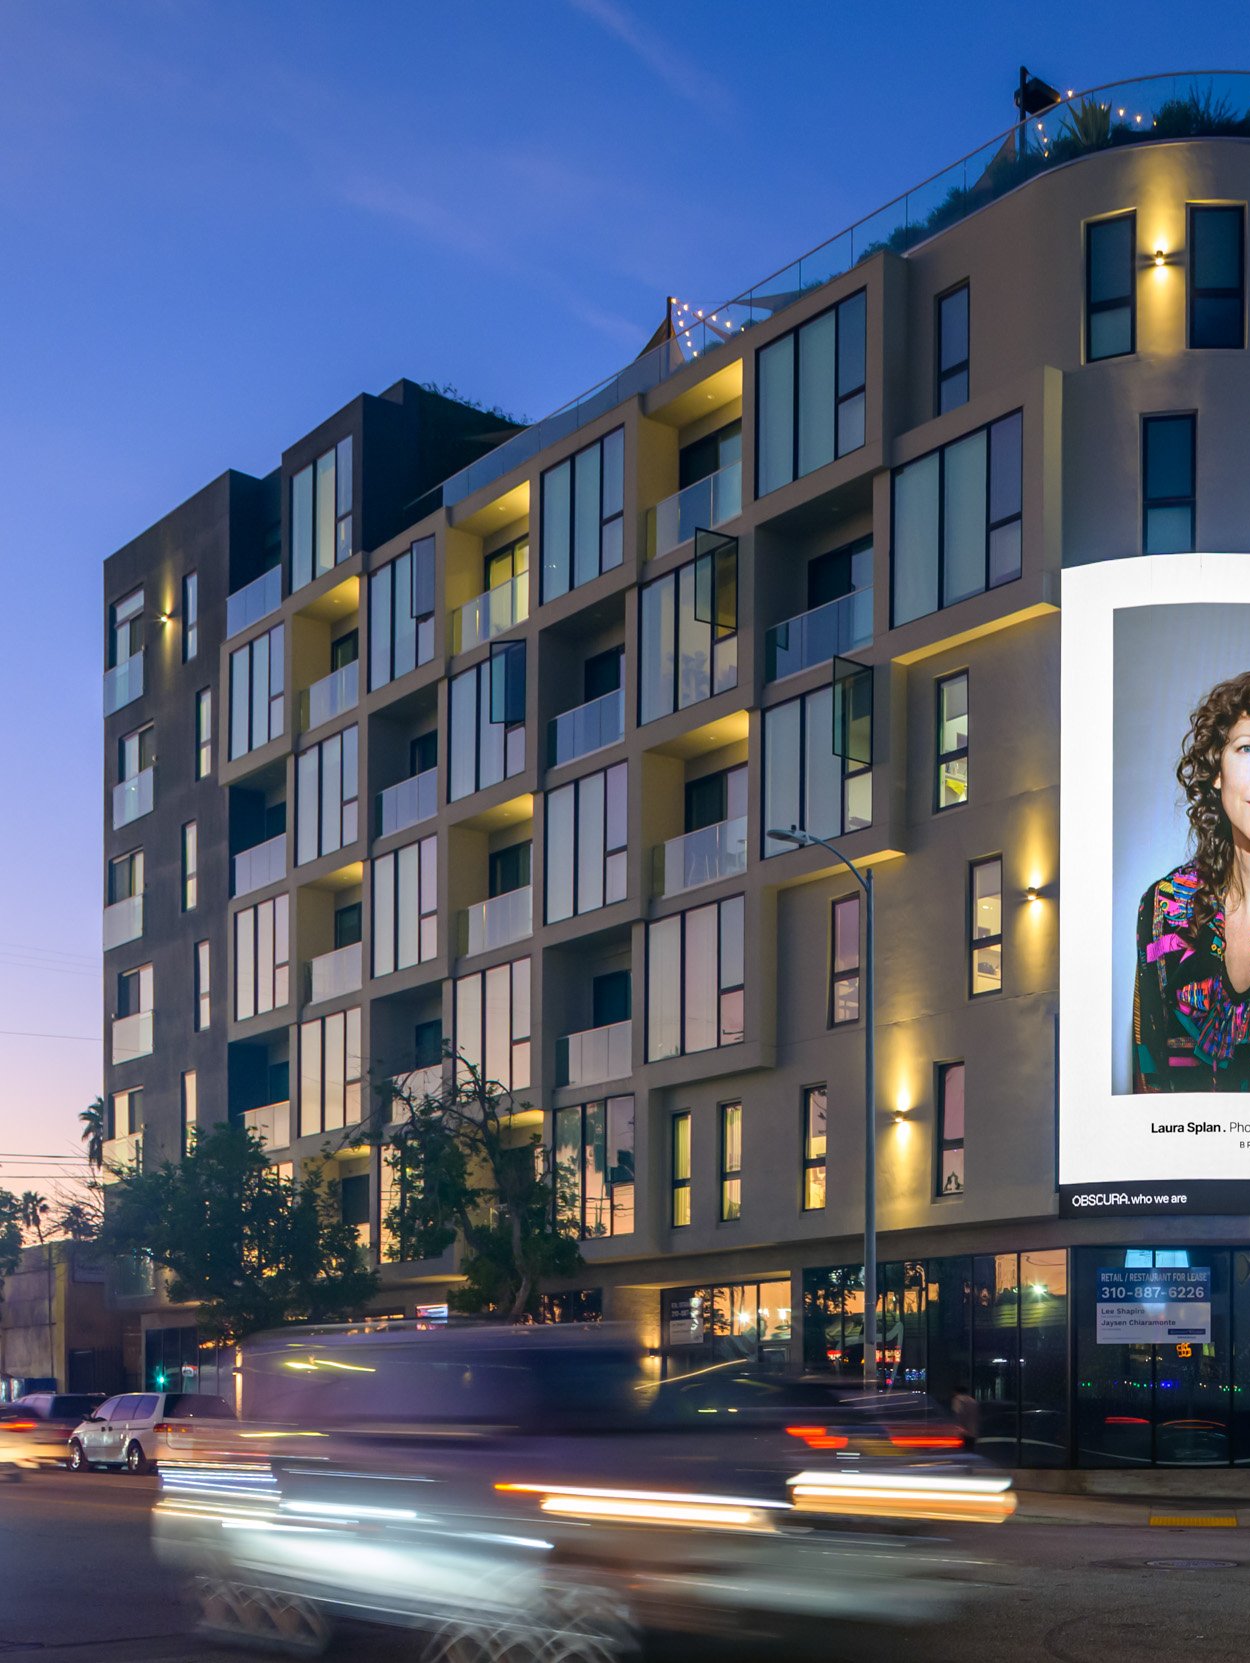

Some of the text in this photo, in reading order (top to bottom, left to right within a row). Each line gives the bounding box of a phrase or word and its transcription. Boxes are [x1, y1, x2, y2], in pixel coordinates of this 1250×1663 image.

[1151, 1122, 1185, 1134] Laura
[1154, 1195, 1169, 1204] we
[1170, 1194, 1187, 1204] are
[1101, 1273, 1123, 1282] RETAIL
[1129, 1272, 1172, 1282] RESTAURANT
[1173, 1272, 1186, 1281] FOR
[1187, 1272, 1207, 1282] LEASE
[1101, 1318, 1176, 1328] Jaysen Chiaramonte
